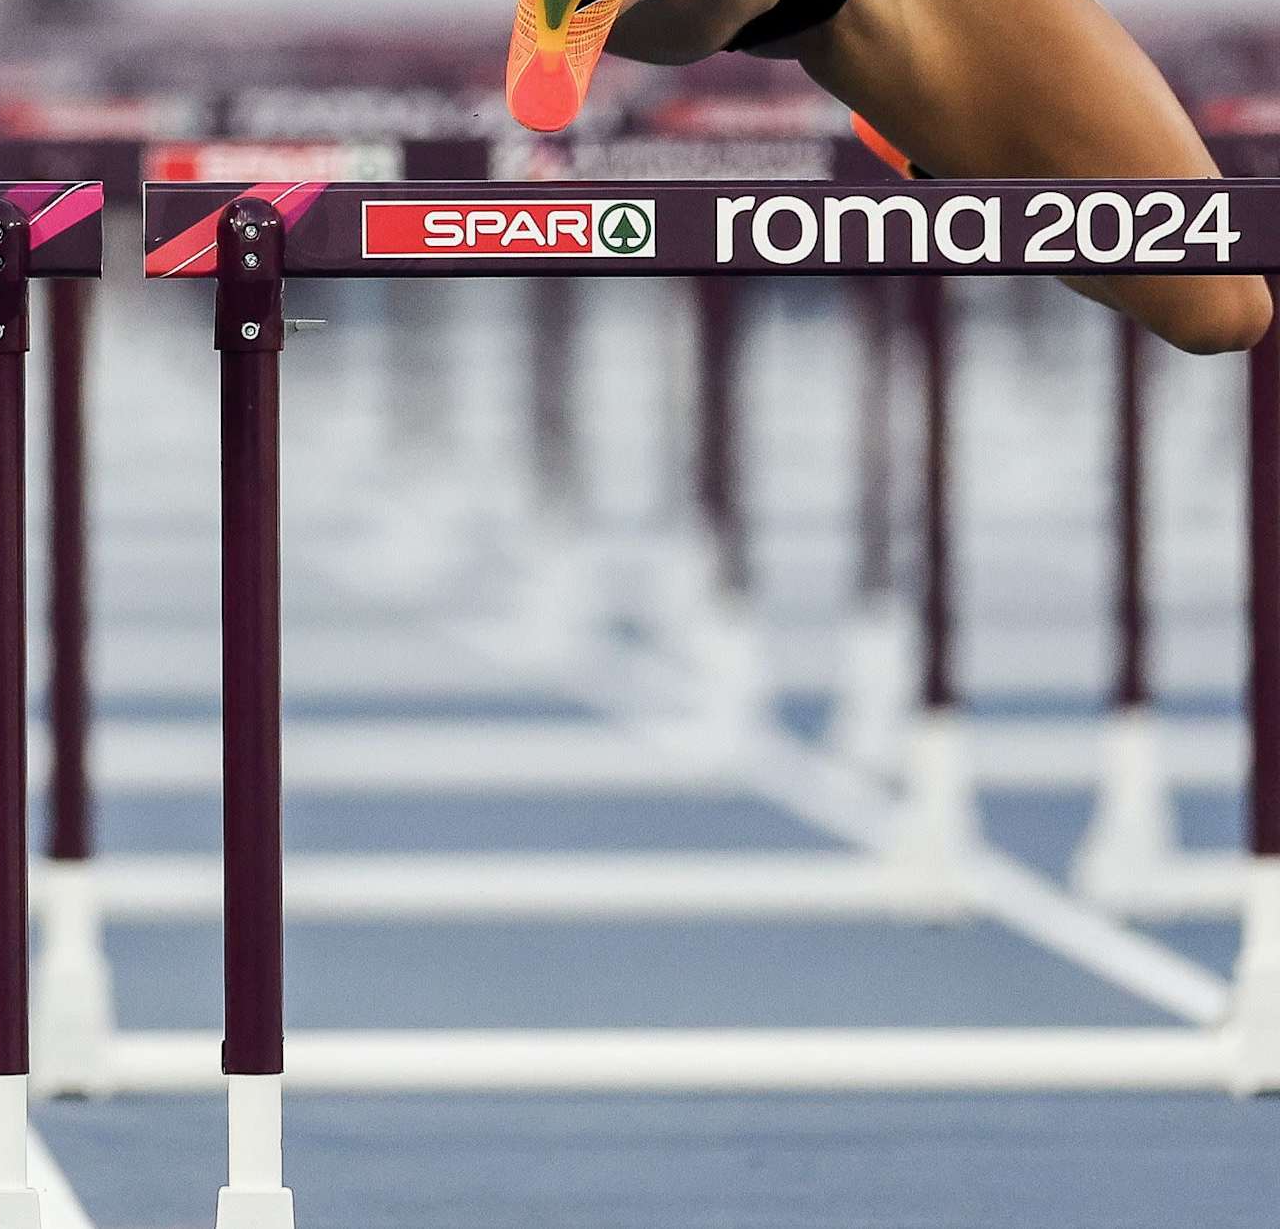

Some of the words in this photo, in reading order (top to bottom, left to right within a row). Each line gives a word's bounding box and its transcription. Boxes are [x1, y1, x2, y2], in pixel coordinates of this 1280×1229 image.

[421, 210, 589, 248] SPAR
[716, 195, 1002, 264] roma
[1024, 191, 1241, 264] 2024
